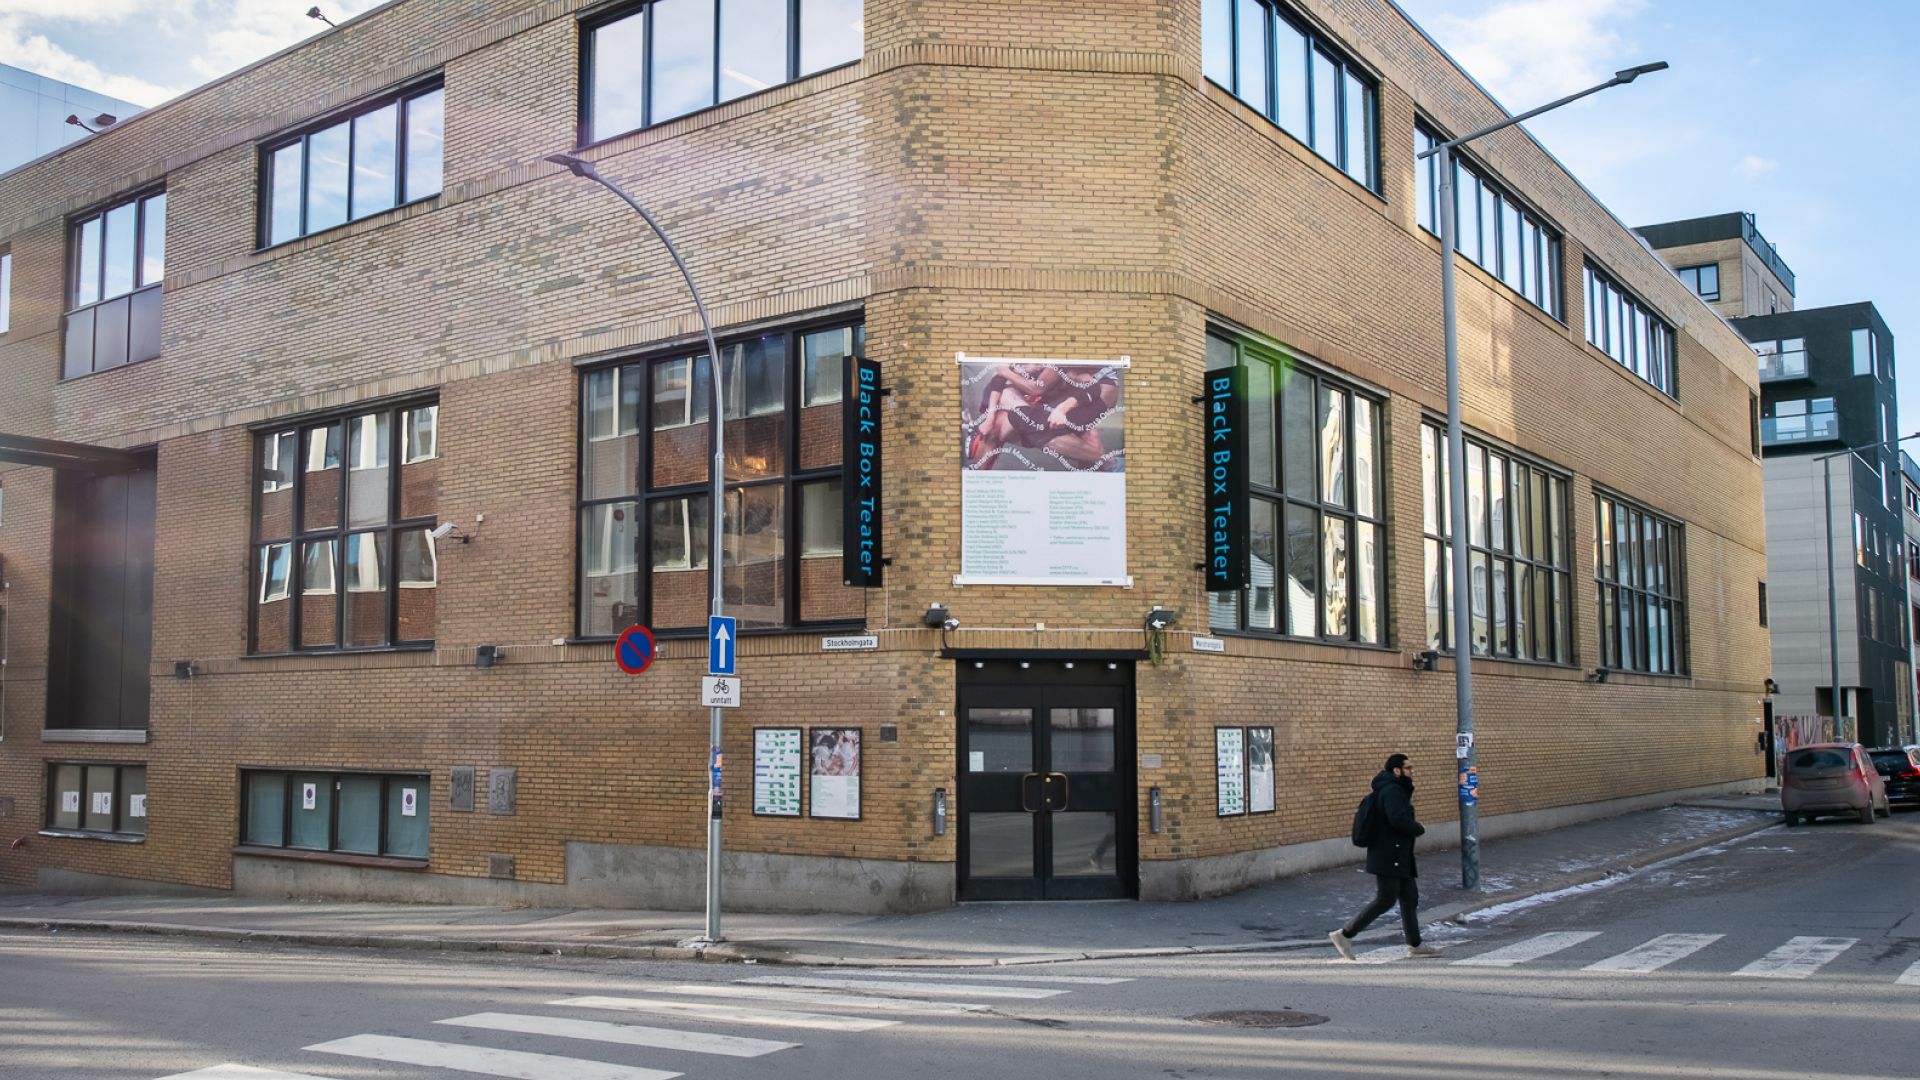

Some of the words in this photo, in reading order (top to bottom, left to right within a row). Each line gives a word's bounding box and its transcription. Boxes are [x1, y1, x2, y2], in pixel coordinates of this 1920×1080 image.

[860, 367, 875, 433] Black
[1012, 406, 1031, 424] March
[1213, 377, 1231, 442] Black
[1085, 418, 1101, 431] 2019
[1099, 407, 1116, 420] Oslo
[860, 442, 874, 487] Box
[969, 447, 1012, 470] Teaterfestival
[1012, 448, 1031, 467] March
[1042, 446, 1060, 459] Oslo
[1213, 450, 1230, 495] Box
[860, 497, 874, 576] Teater
[1214, 501, 1231, 580] Teater
[826, 638, 873, 648] Stockholmgata
[710, 696, 732, 705] unntatt
